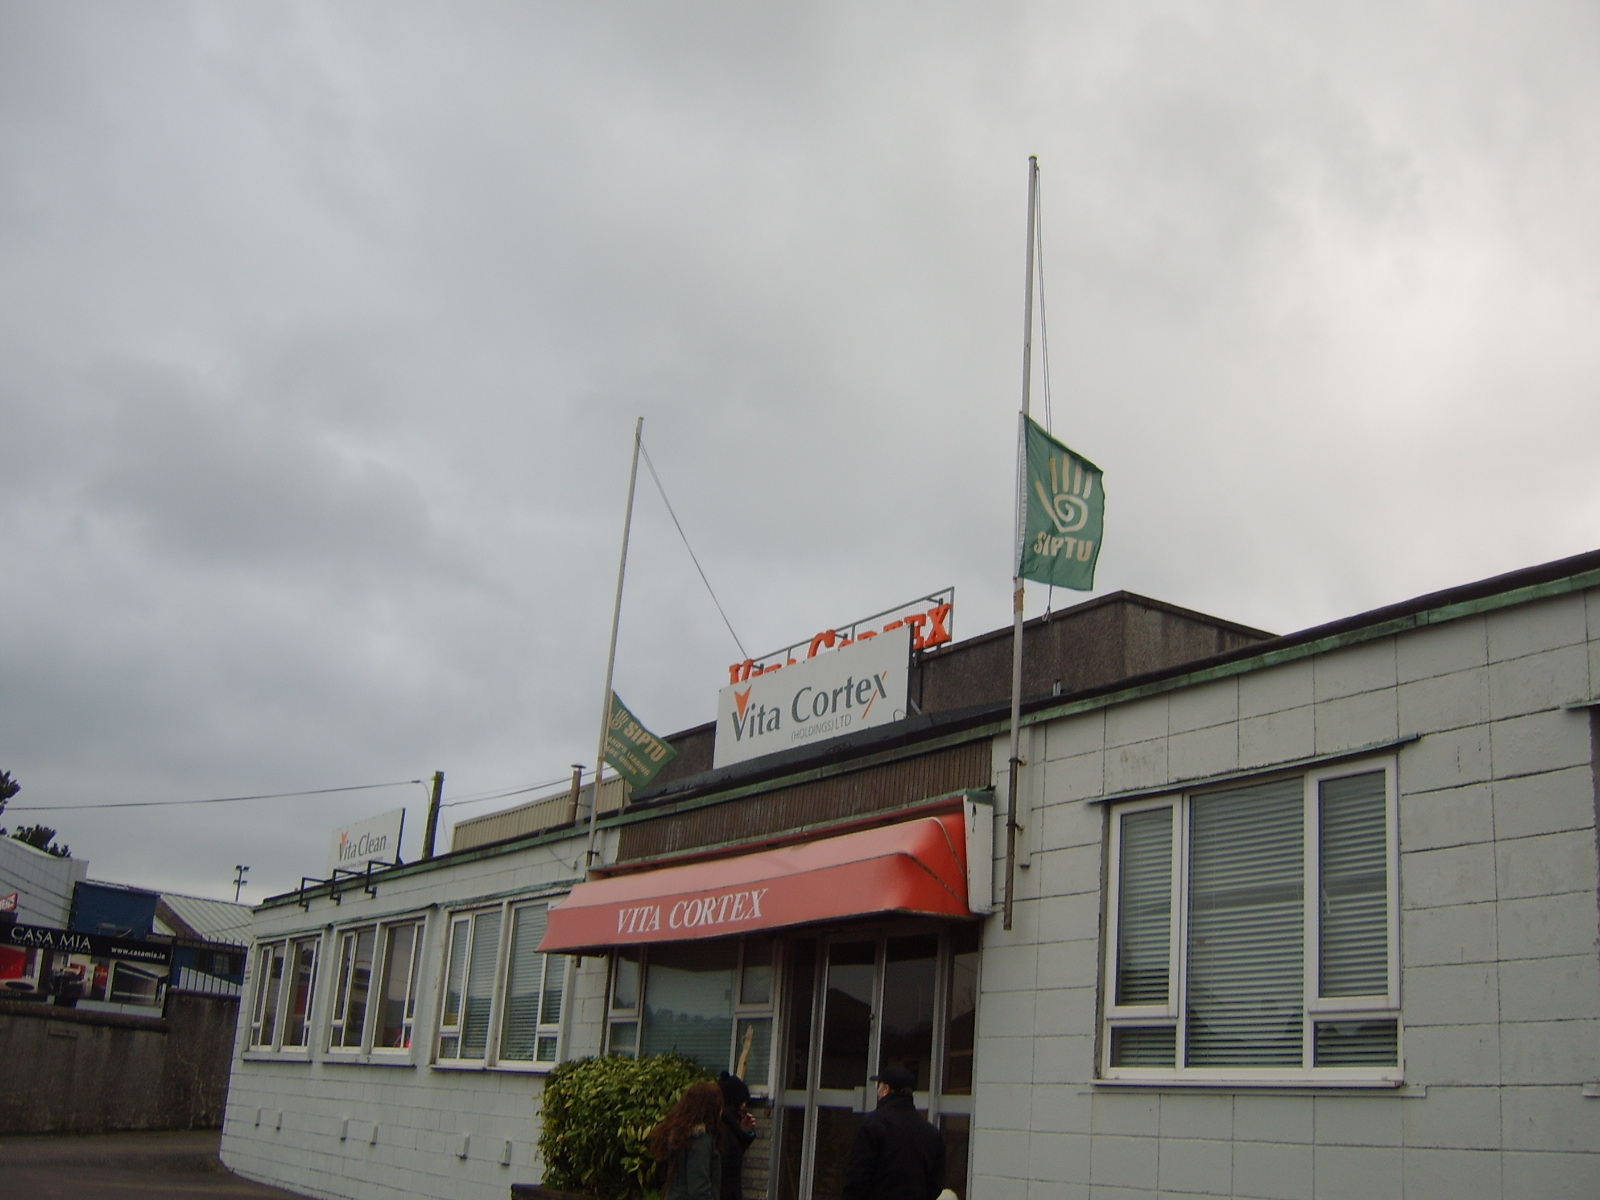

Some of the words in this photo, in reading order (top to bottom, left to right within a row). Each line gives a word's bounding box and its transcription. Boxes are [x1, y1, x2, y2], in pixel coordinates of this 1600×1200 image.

[1033, 531, 1094, 562] SIPTU
[731, 684, 781, 742] Vita
[791, 670, 887, 720] Cortex
[834, 713, 852, 731] LTD
[623, 721, 668, 763] SIPTU
[339, 831, 357, 861] Vita
[358, 832, 387, 857] Clean
[617, 904, 661, 935] VITA
[668, 888, 769, 930] CORTEX
[11, 926, 54, 945] CASA
[59, 933, 92, 950] MIA
[111, 946, 166, 960] www.casamia.ie
